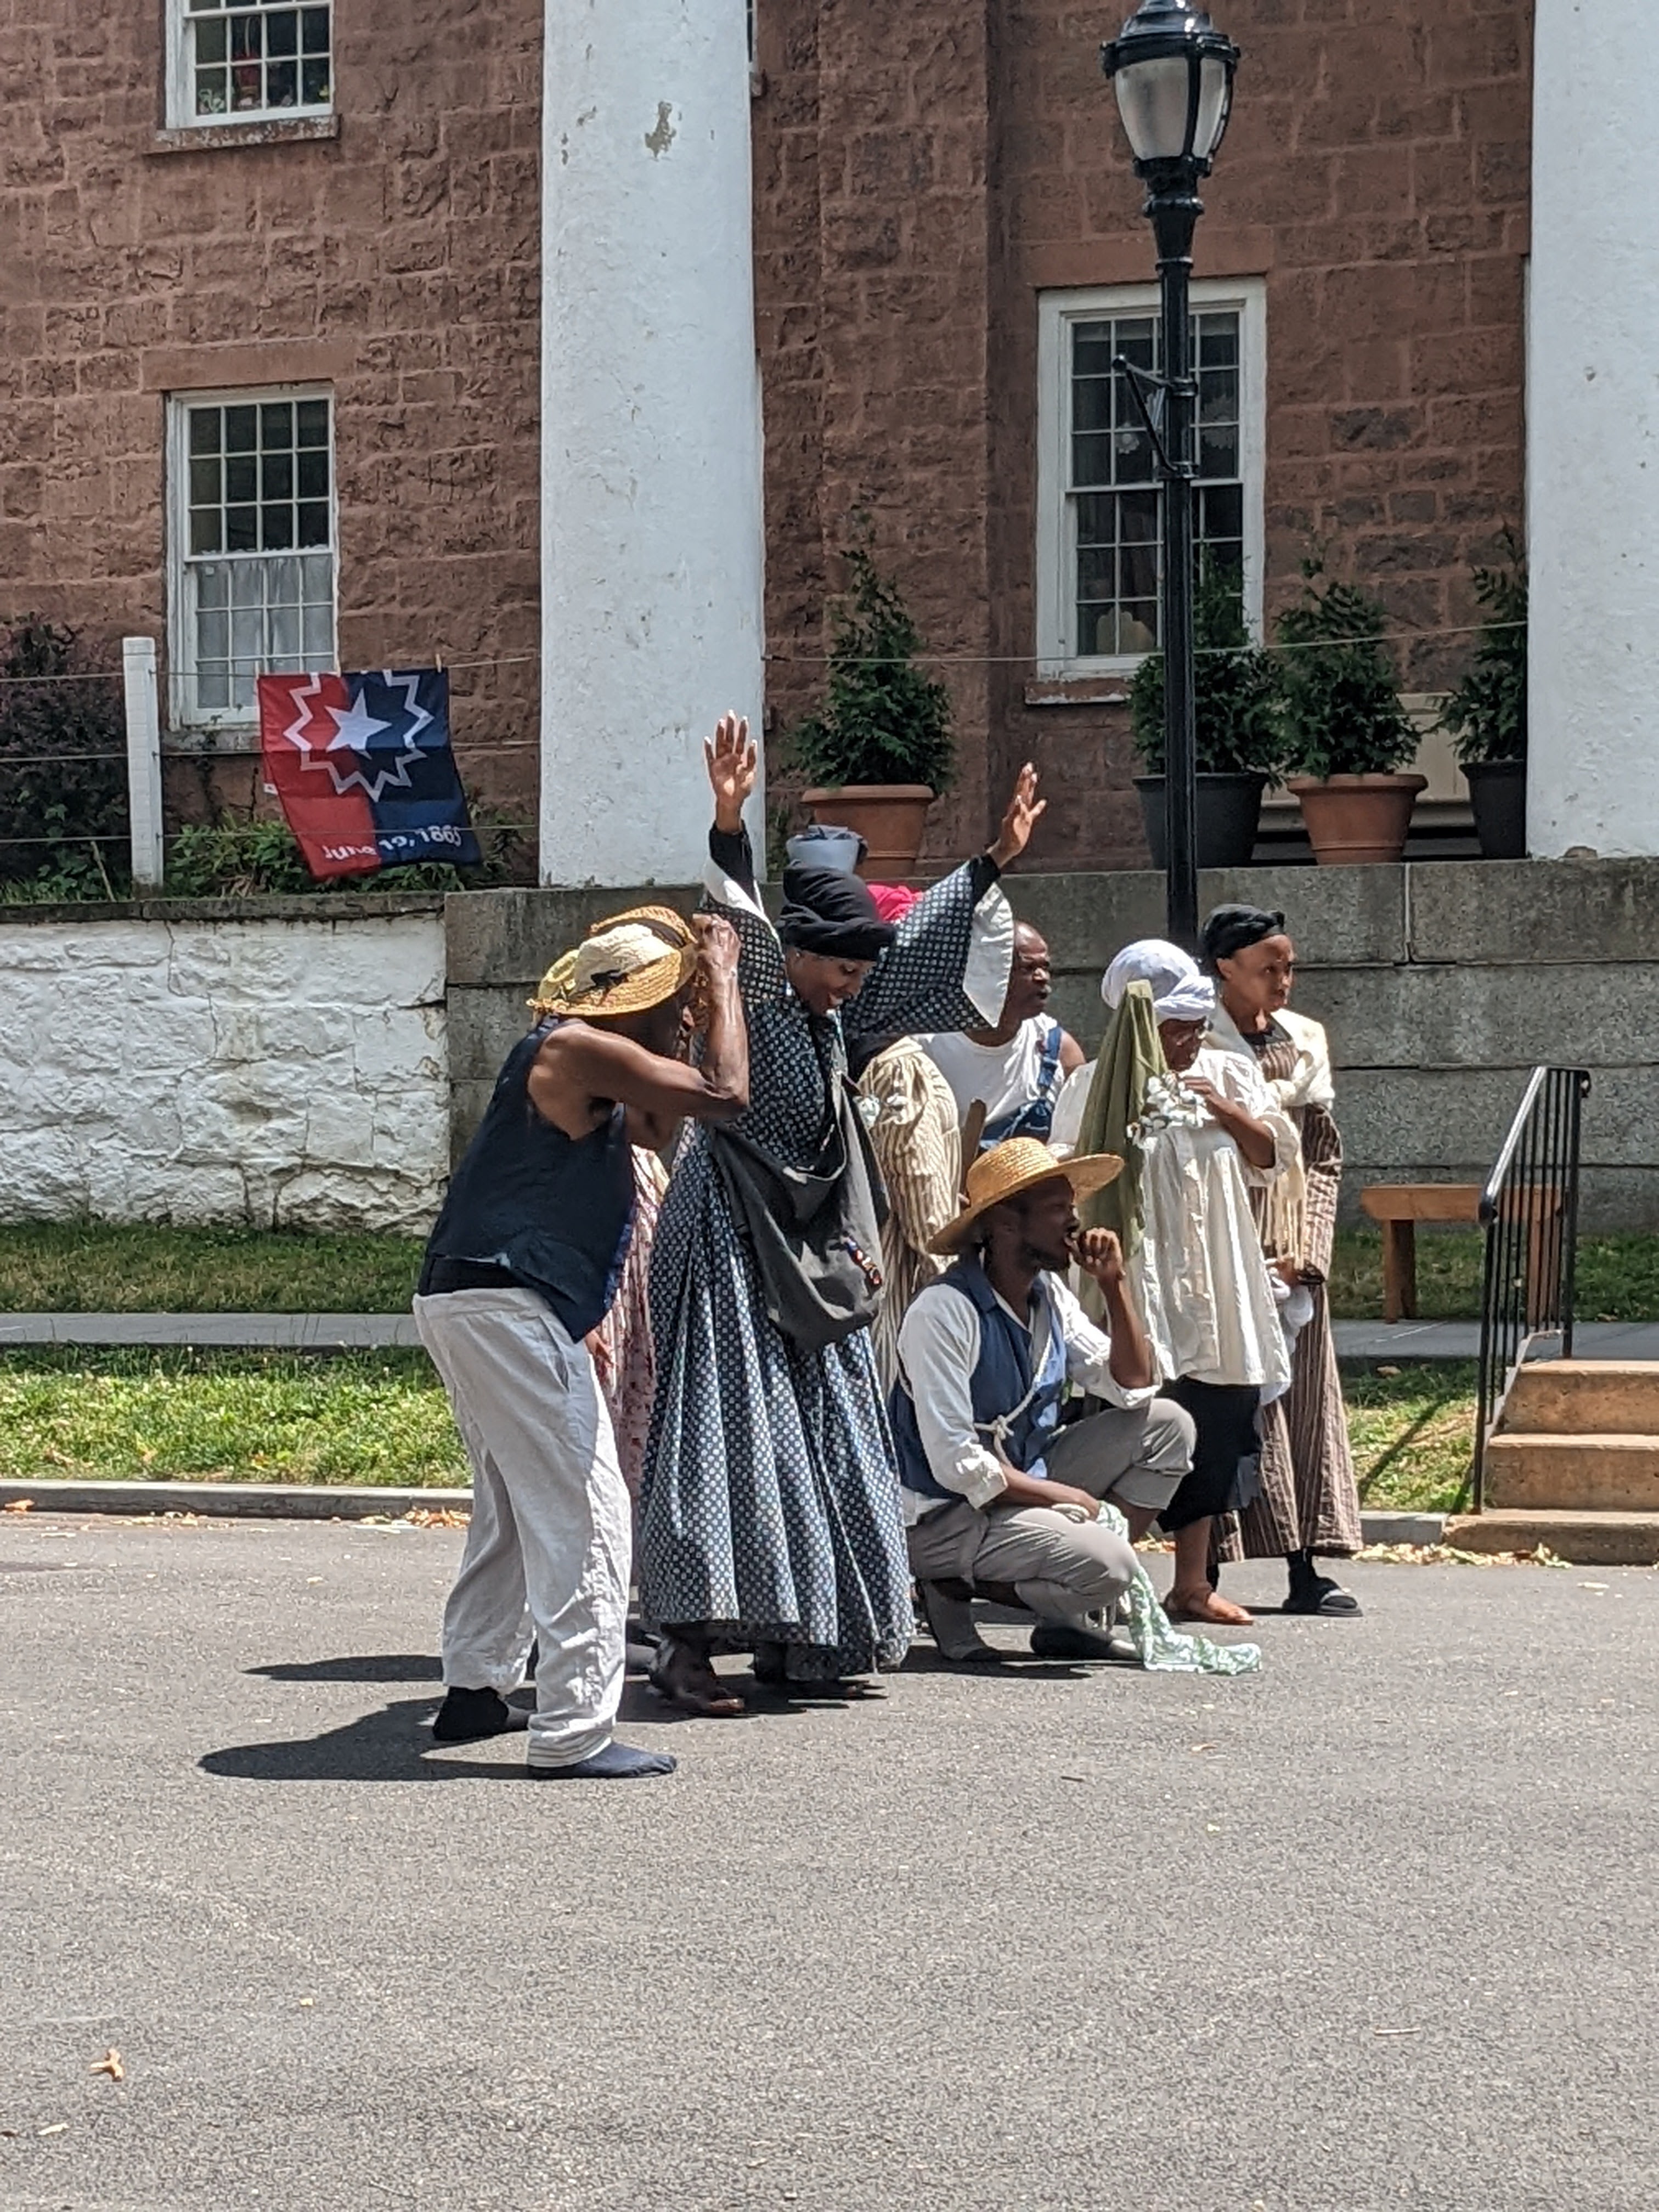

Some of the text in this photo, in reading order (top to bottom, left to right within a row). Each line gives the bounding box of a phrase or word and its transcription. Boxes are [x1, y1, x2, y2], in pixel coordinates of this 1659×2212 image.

[323, 825, 462, 860] June 19, 1865
